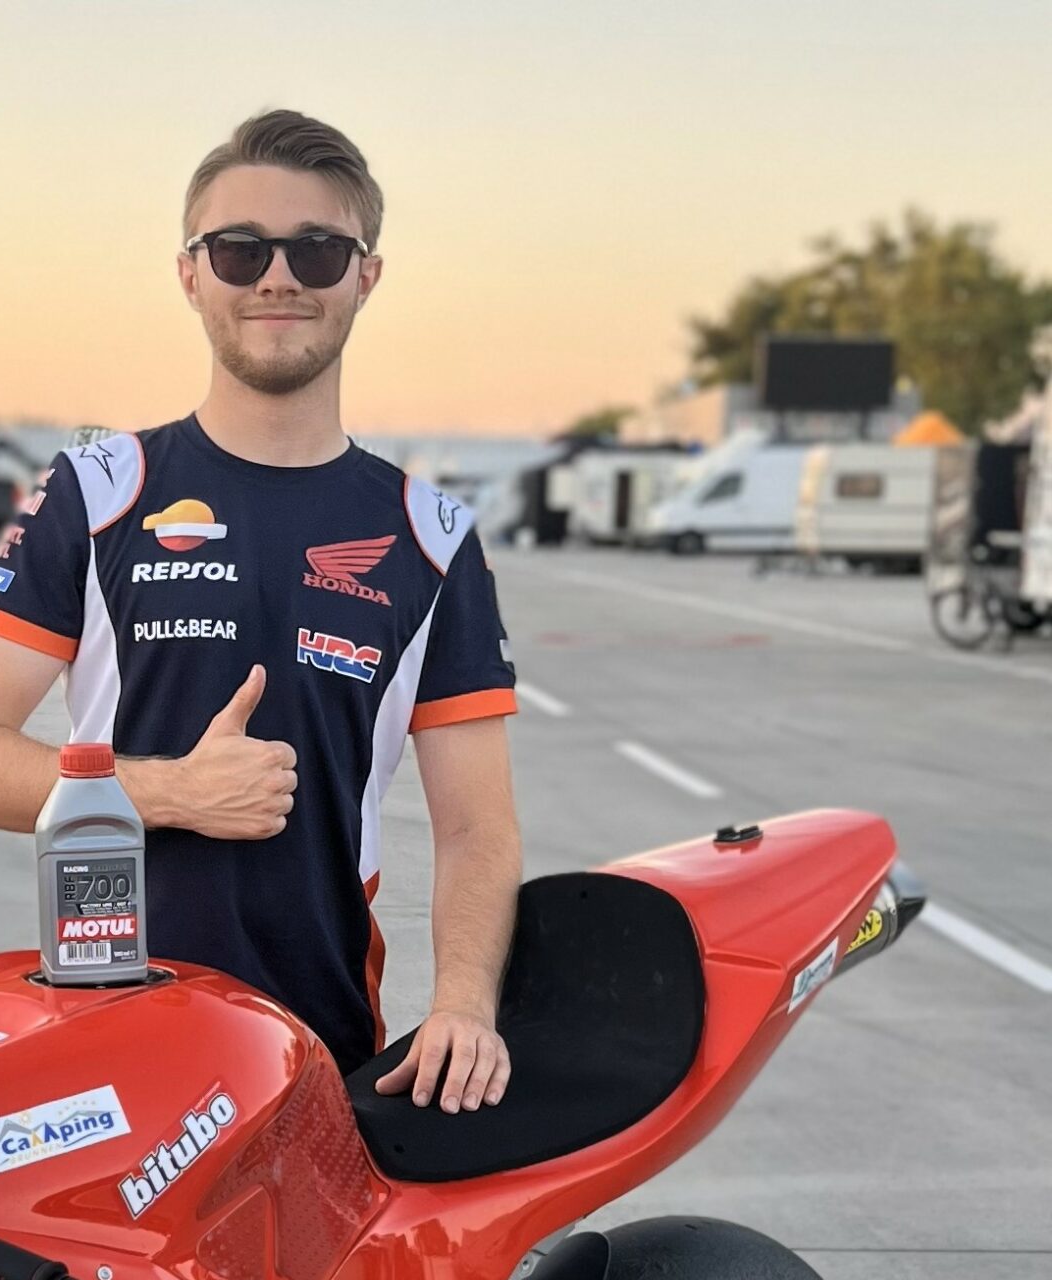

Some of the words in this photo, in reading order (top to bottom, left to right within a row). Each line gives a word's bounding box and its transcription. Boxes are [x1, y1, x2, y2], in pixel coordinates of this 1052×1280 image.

[131, 561, 238, 583] REPSOL
[302, 571, 392, 607] HONDA
[133, 619, 237, 642] PULL&BEAR
[296, 627, 383, 684] HRC
[64, 876, 76, 901] RBF
[77, 874, 132, 902] 700
[62, 918, 135, 938] MOTUL
[119, 1094, 236, 1219] bitubo
